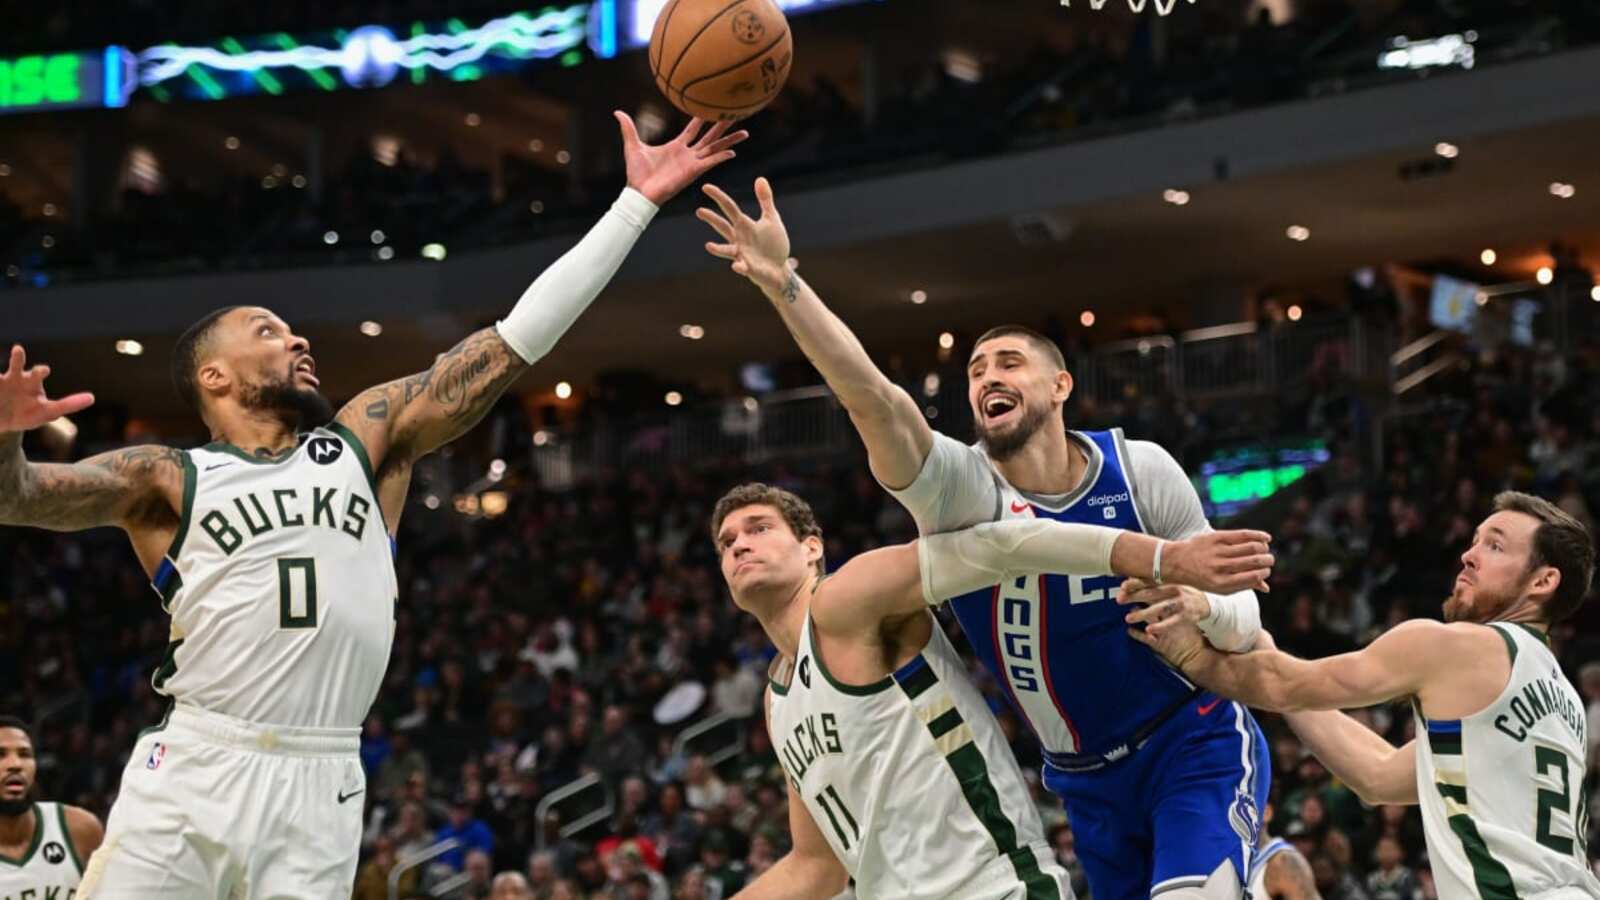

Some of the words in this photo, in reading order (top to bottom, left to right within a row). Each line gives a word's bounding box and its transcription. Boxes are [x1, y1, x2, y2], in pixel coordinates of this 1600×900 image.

[200, 487, 370, 556] BUCKS
[1087, 491, 1128, 507] dialpad
[277, 557, 318, 628] 0
[1494, 679, 1585, 752] CONNAUGH
[816, 784, 860, 851] 11
